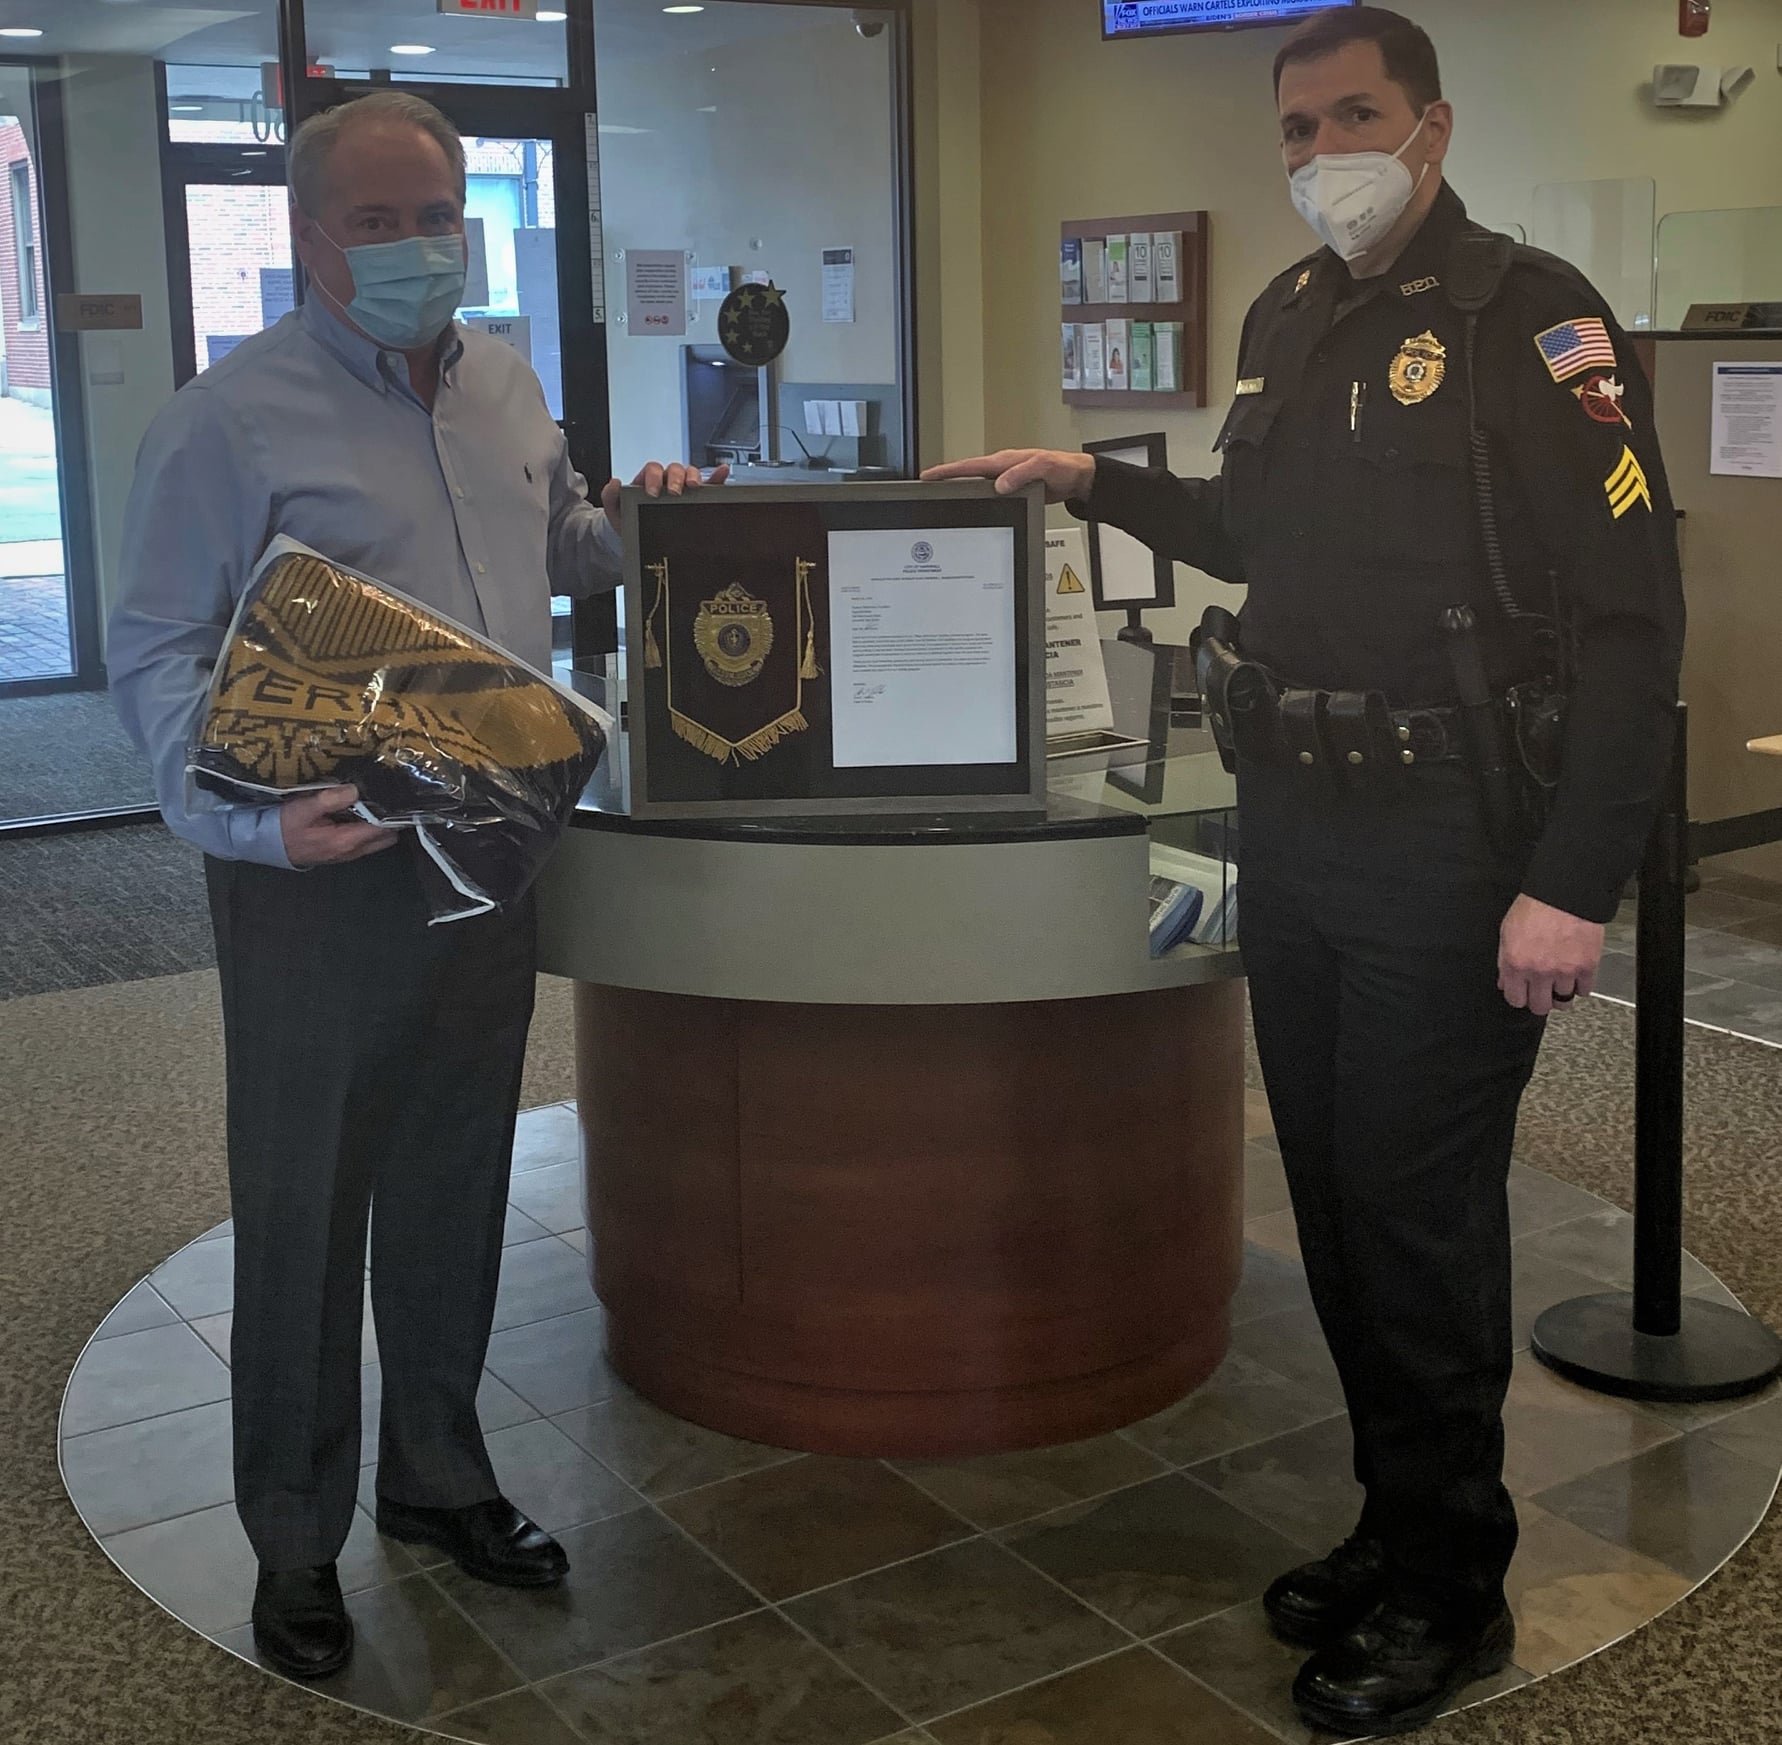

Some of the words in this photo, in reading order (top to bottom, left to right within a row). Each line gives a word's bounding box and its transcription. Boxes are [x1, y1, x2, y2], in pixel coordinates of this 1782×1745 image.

[1143, 5, 1179, 16] OFFICIALS
[1180, 3, 1204, 13] WARN
[1205, 0, 1236, 11] CARTELS
[1135, 246, 1147, 258] 10
[1160, 245, 1172, 258] 10
[80, 303, 115, 316] FDIC
[1704, 311, 1741, 322] FDIC
[488, 323, 512, 334] EXIT
[710, 604, 757, 613] POLICE
[1045, 639, 1081, 649] ANTENER
